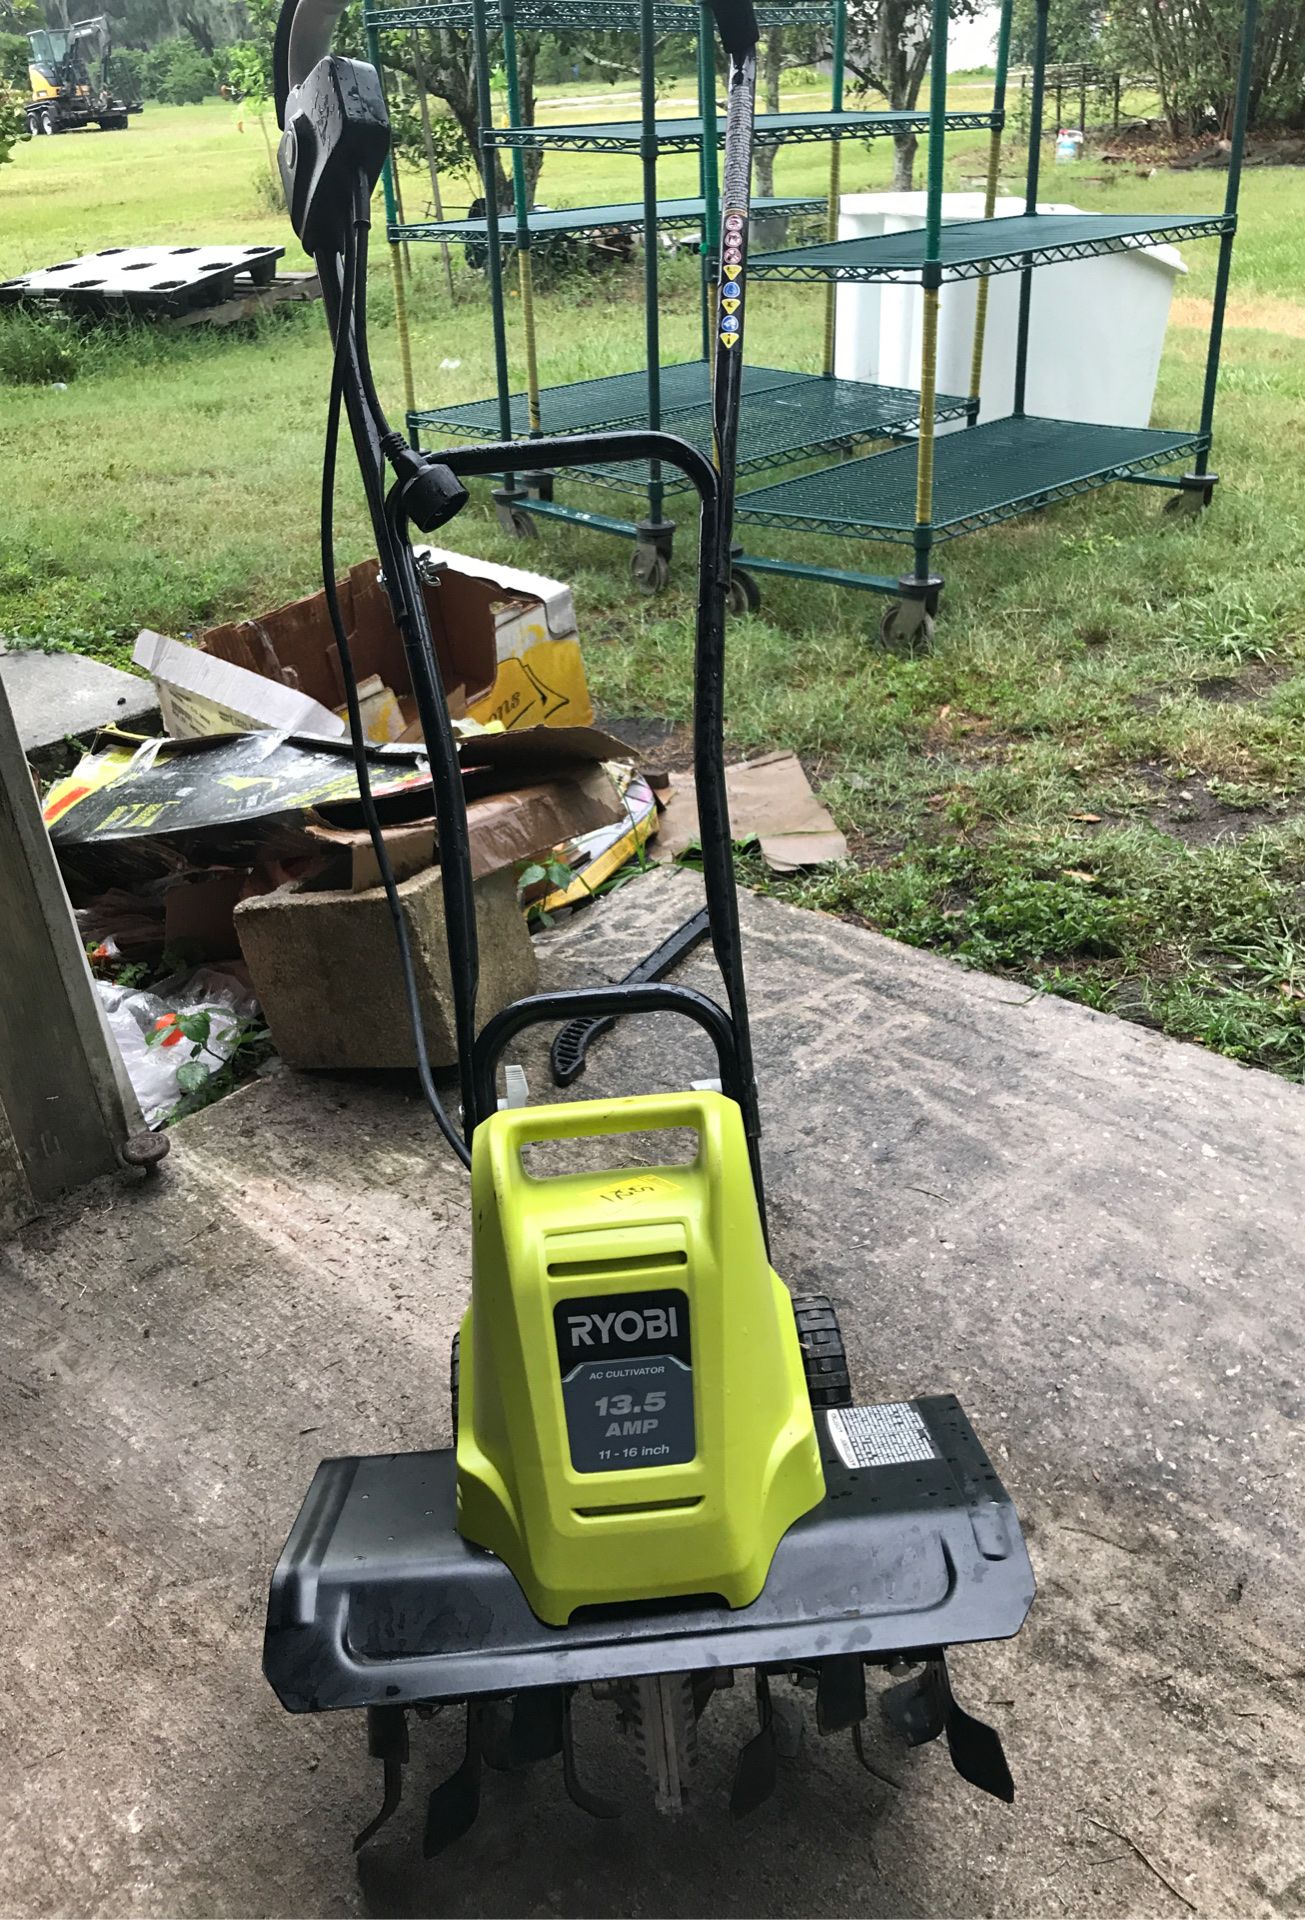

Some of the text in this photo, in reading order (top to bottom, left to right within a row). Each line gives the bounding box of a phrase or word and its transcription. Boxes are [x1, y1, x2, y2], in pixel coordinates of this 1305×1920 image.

[567, 1306, 679, 1347] RYOBI
[589, 1366, 665, 1380] AC CULTIVATOR
[594, 1391, 667, 1417] 13.5
[605, 1418, 659, 1437] AMP
[598, 1449, 612, 1460] 11
[622, 1447, 638, 1458] 16
[641, 1444, 670, 1457] inch
